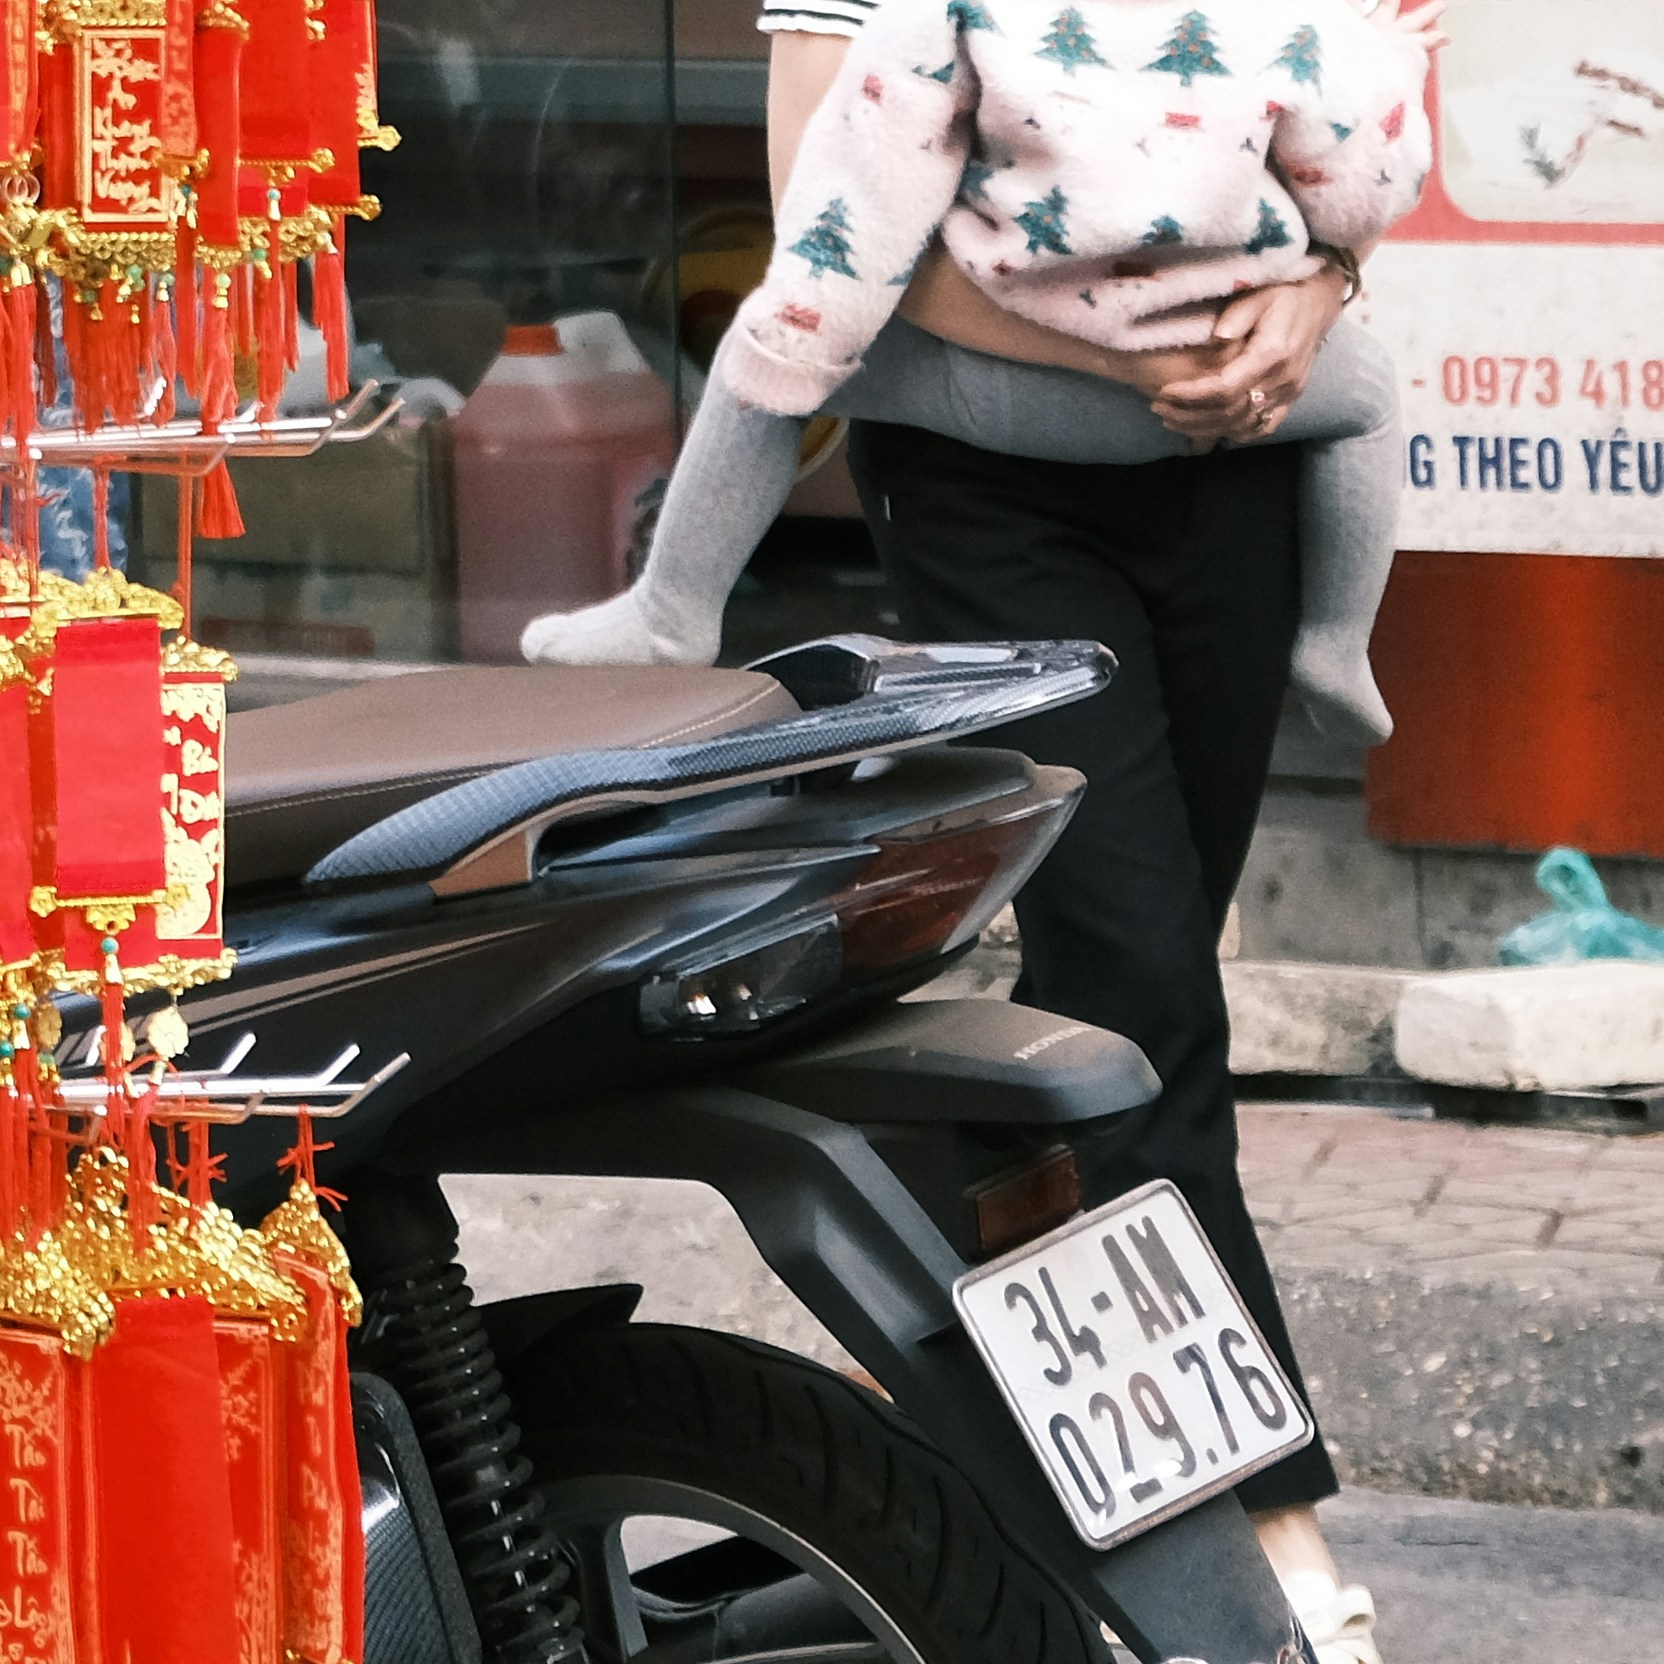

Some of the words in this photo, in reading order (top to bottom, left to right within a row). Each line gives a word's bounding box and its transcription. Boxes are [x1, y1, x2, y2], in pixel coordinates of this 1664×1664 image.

[1442, 356, 1561, 406] 0973
[1453, 436, 1562, 492] THEO
[1581, 428, 1664, 496] YÊU
[1048, 1326, 1288, 1518] 029.76
